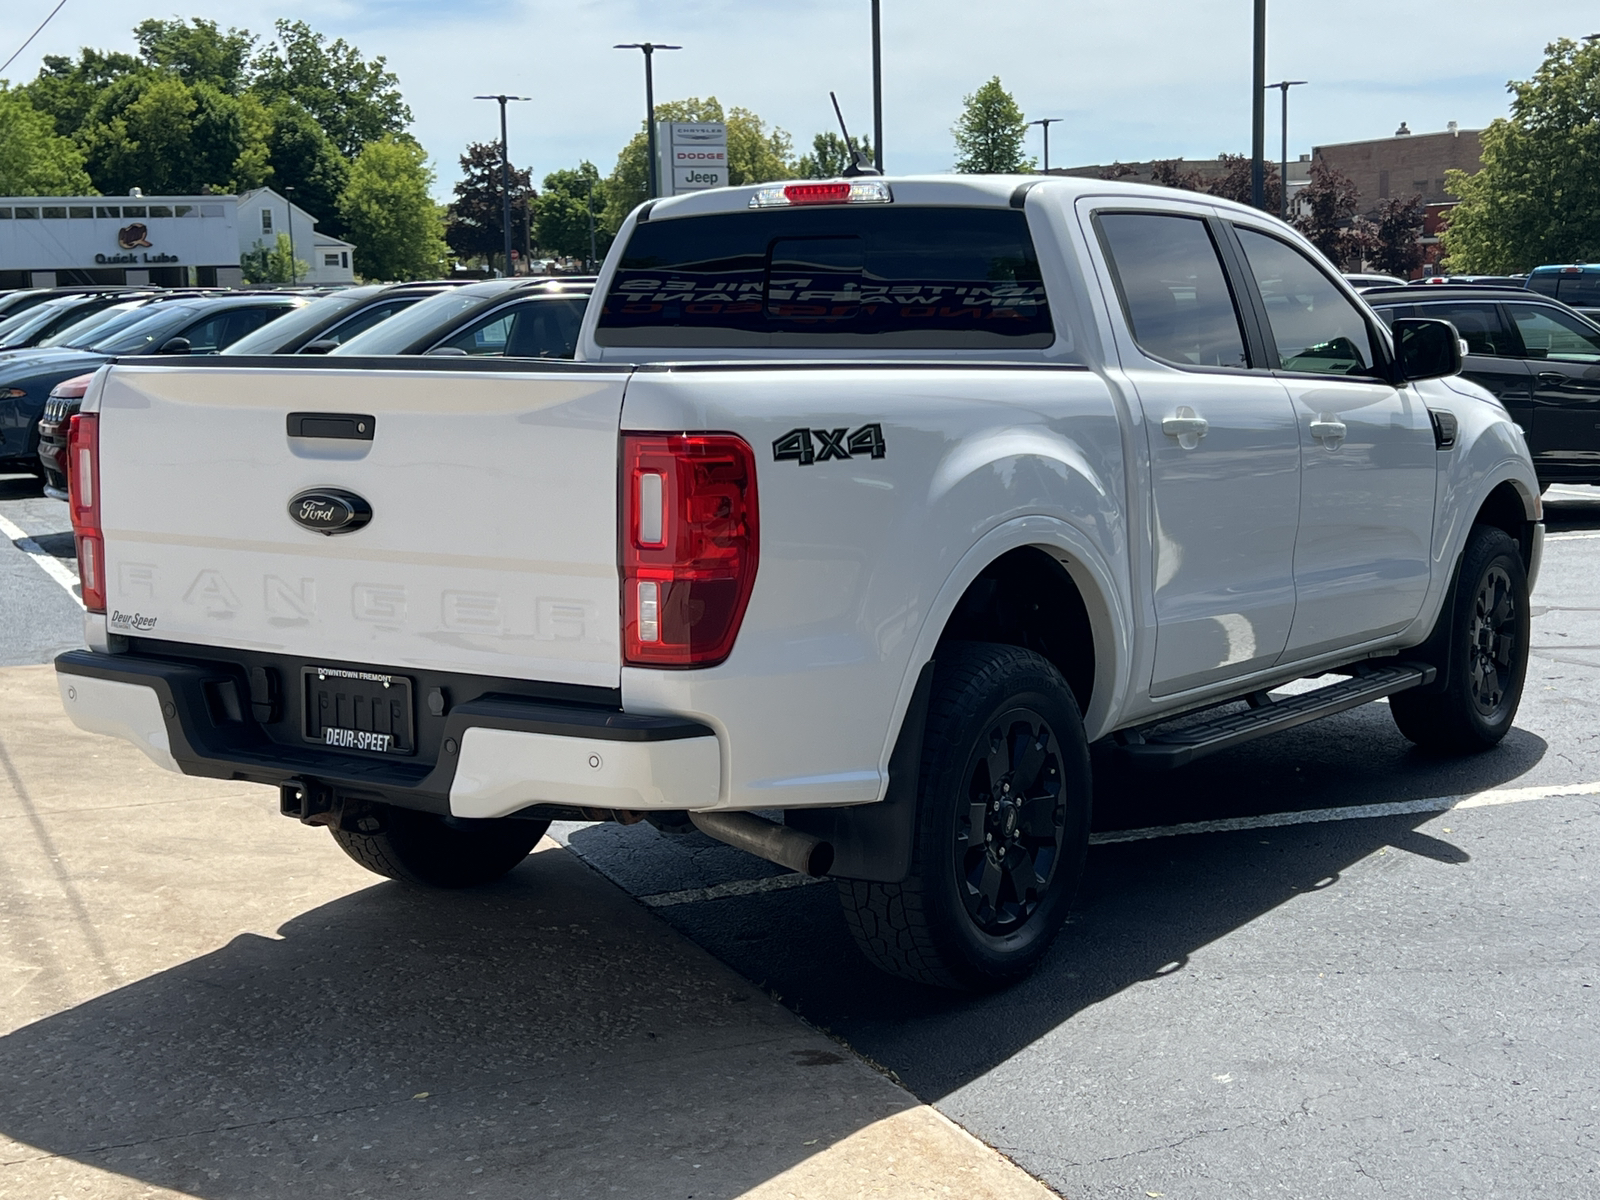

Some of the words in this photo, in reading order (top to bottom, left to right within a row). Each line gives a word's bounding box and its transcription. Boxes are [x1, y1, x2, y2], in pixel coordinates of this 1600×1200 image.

[677, 152, 724, 160] DODGE
[685, 170, 718, 185] Jeep
[95, 253, 138, 264] Quick
[143, 252, 178, 263] Lube
[300, 499, 335, 521] Ford
[117, 561, 594, 641] RANGER
[111, 610, 132, 622] Deur
[132, 613, 157, 628] Speet
[318, 668, 358, 679] DOWNTOWN
[359, 672, 392, 682] FREMONT
[326, 728, 390, 752] DEUR-SPEET
